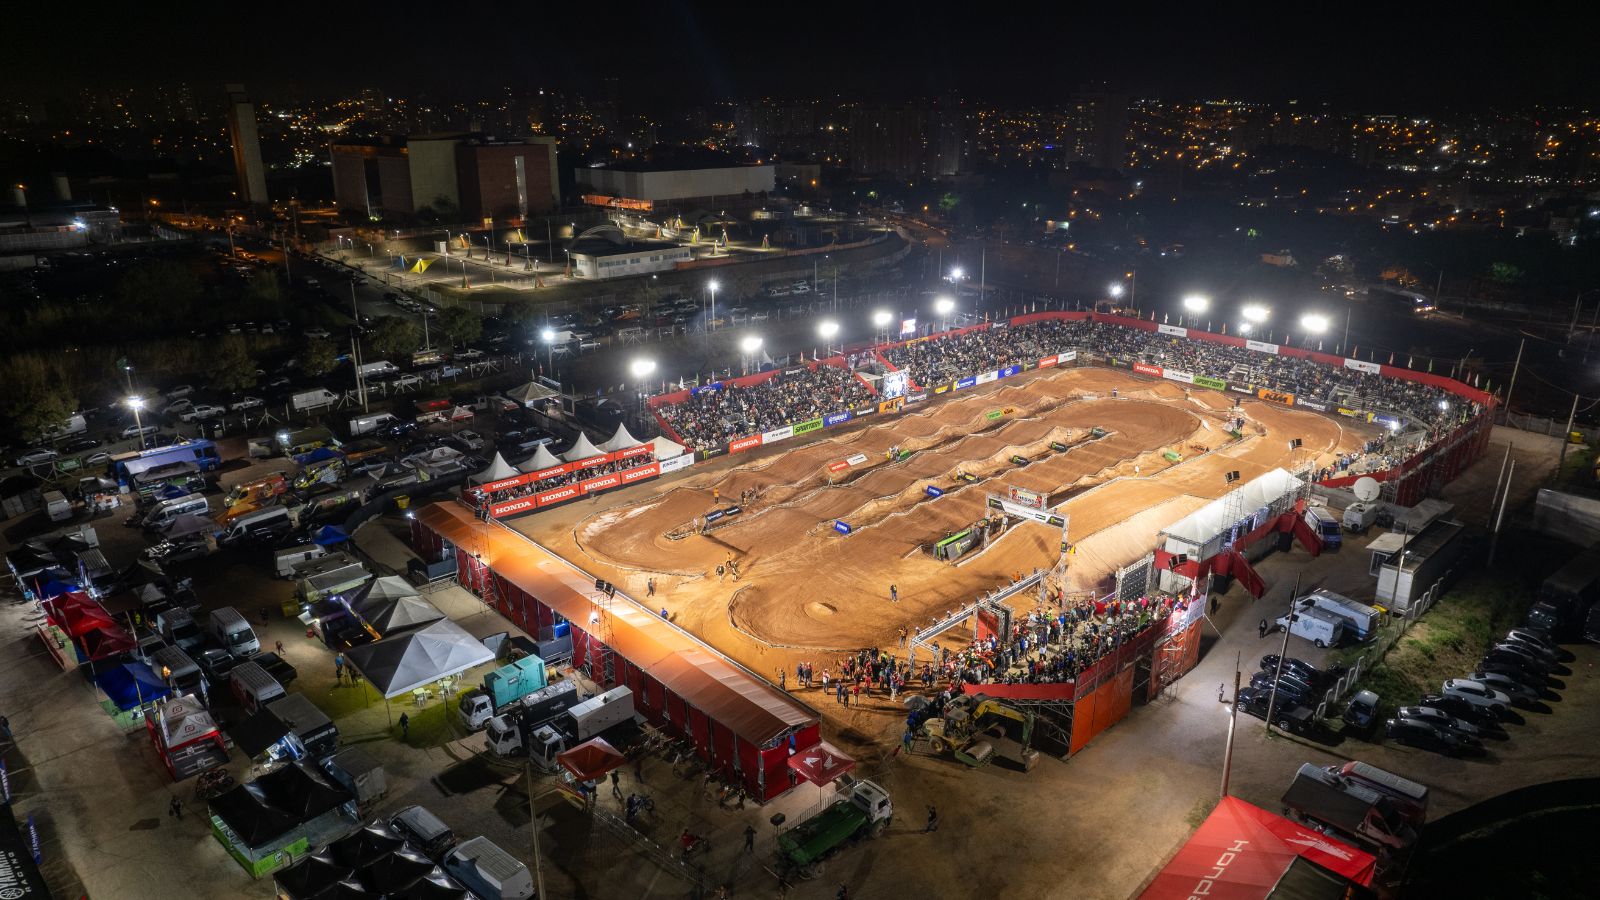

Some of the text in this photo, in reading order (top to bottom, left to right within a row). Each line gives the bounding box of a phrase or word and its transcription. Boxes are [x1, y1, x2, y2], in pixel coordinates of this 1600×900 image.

[1136, 365, 1160, 374] HONDA
[1264, 393, 1288, 404] KTM
[733, 438, 759, 451] HONDA
[623, 447, 647, 457] HONDA
[581, 457, 607, 467] HONDA
[538, 467, 565, 478] HONDA
[625, 467, 656, 480] HONDA
[492, 479, 520, 489] HONDA
[584, 478, 617, 491] HONDA
[541, 489, 575, 503] HONDA
[495, 501, 532, 515] HONDA
